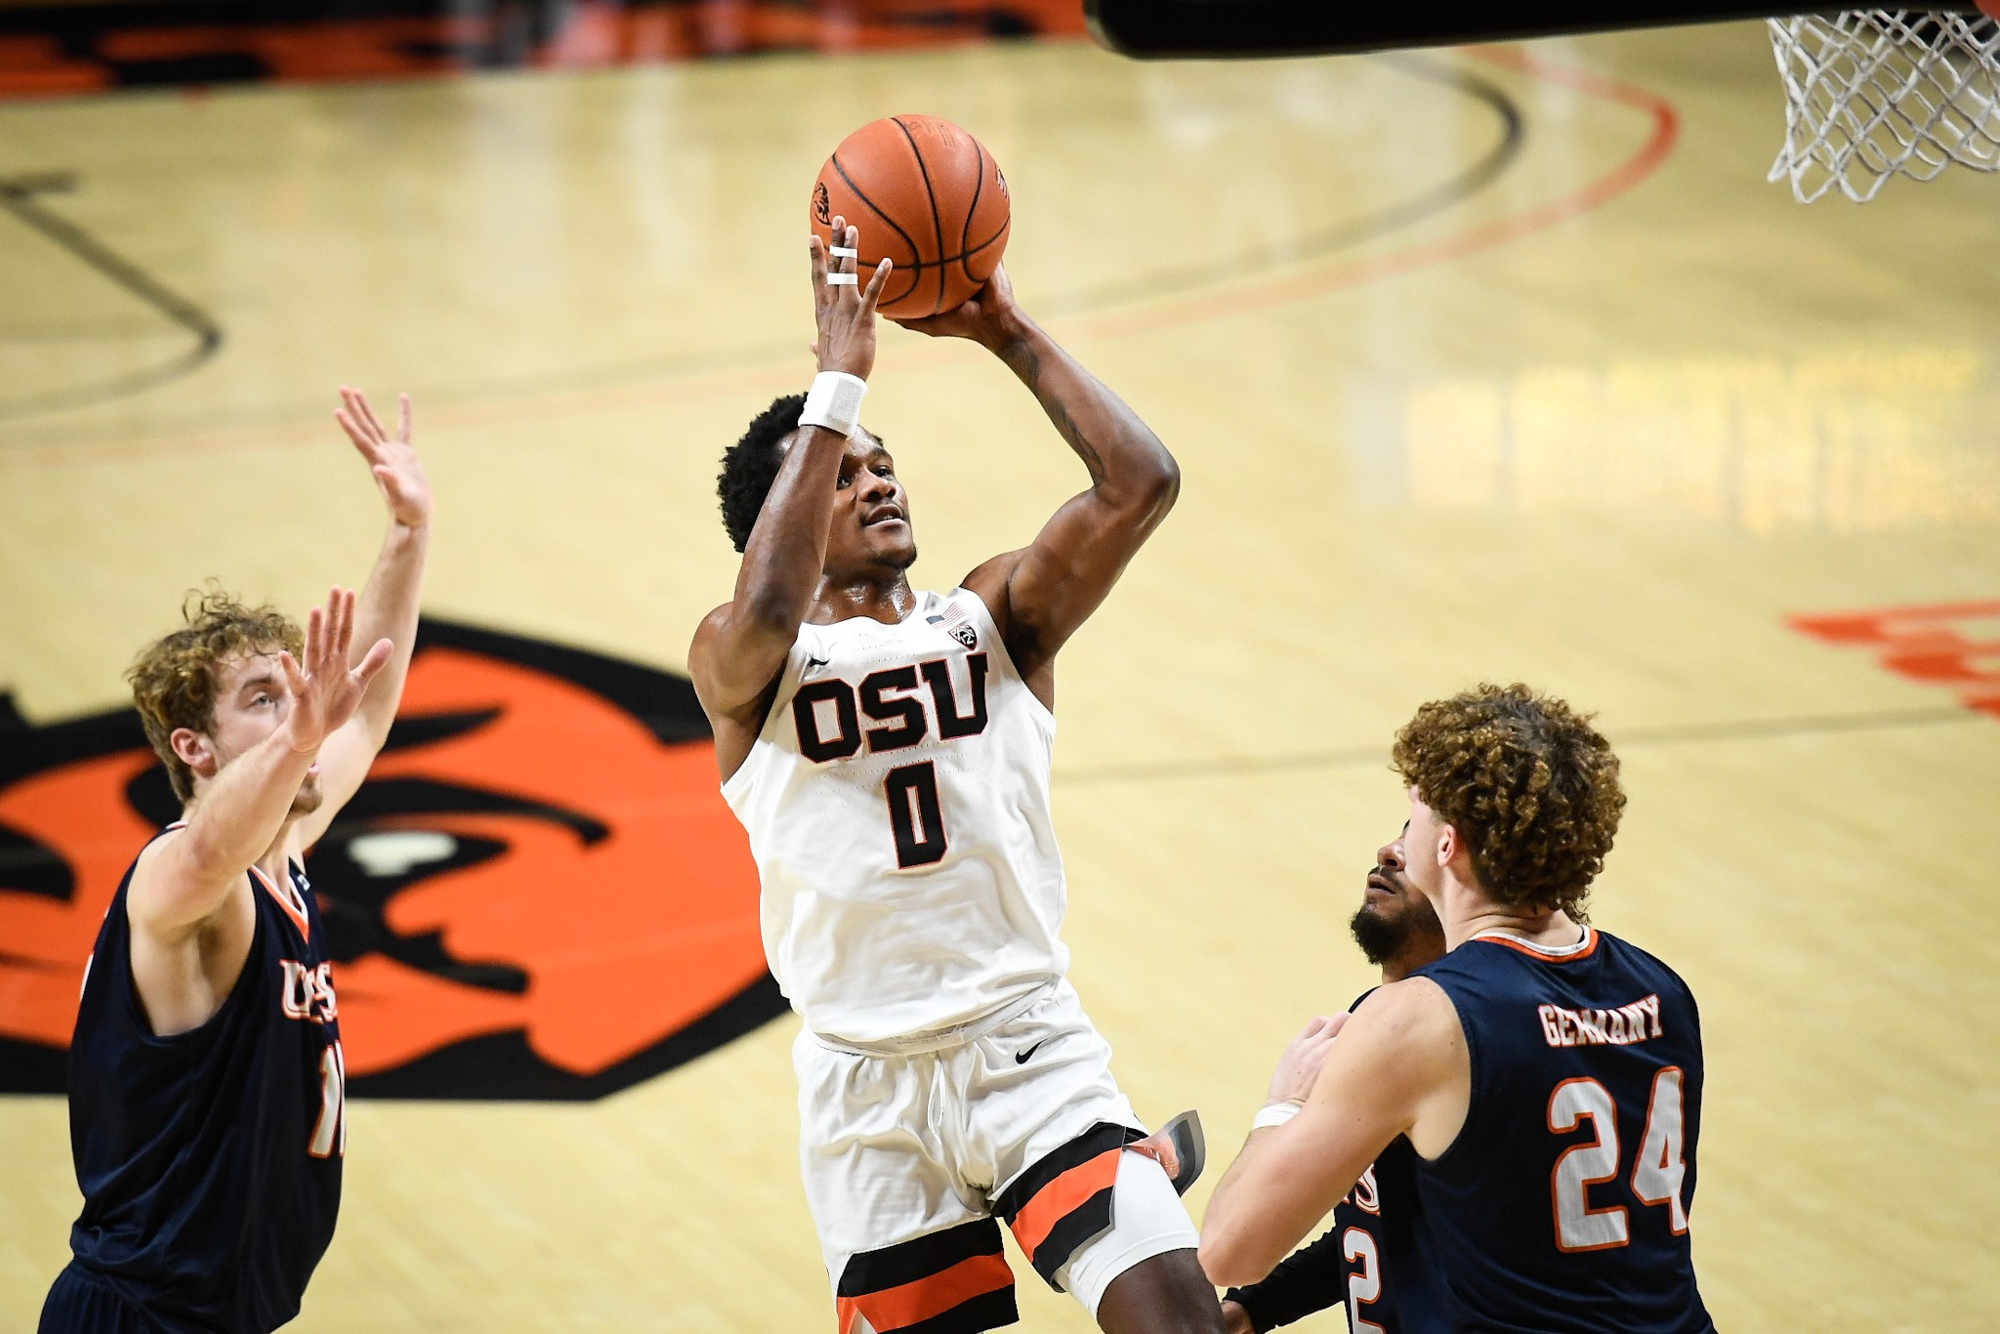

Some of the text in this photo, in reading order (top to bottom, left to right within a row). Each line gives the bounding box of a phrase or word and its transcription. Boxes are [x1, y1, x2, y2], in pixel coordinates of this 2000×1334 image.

[791, 652, 988, 764] OSU
[884, 760, 948, 870] 0
[1547, 1065, 1688, 1253] 24
[1343, 1225, 1386, 1334] 2
